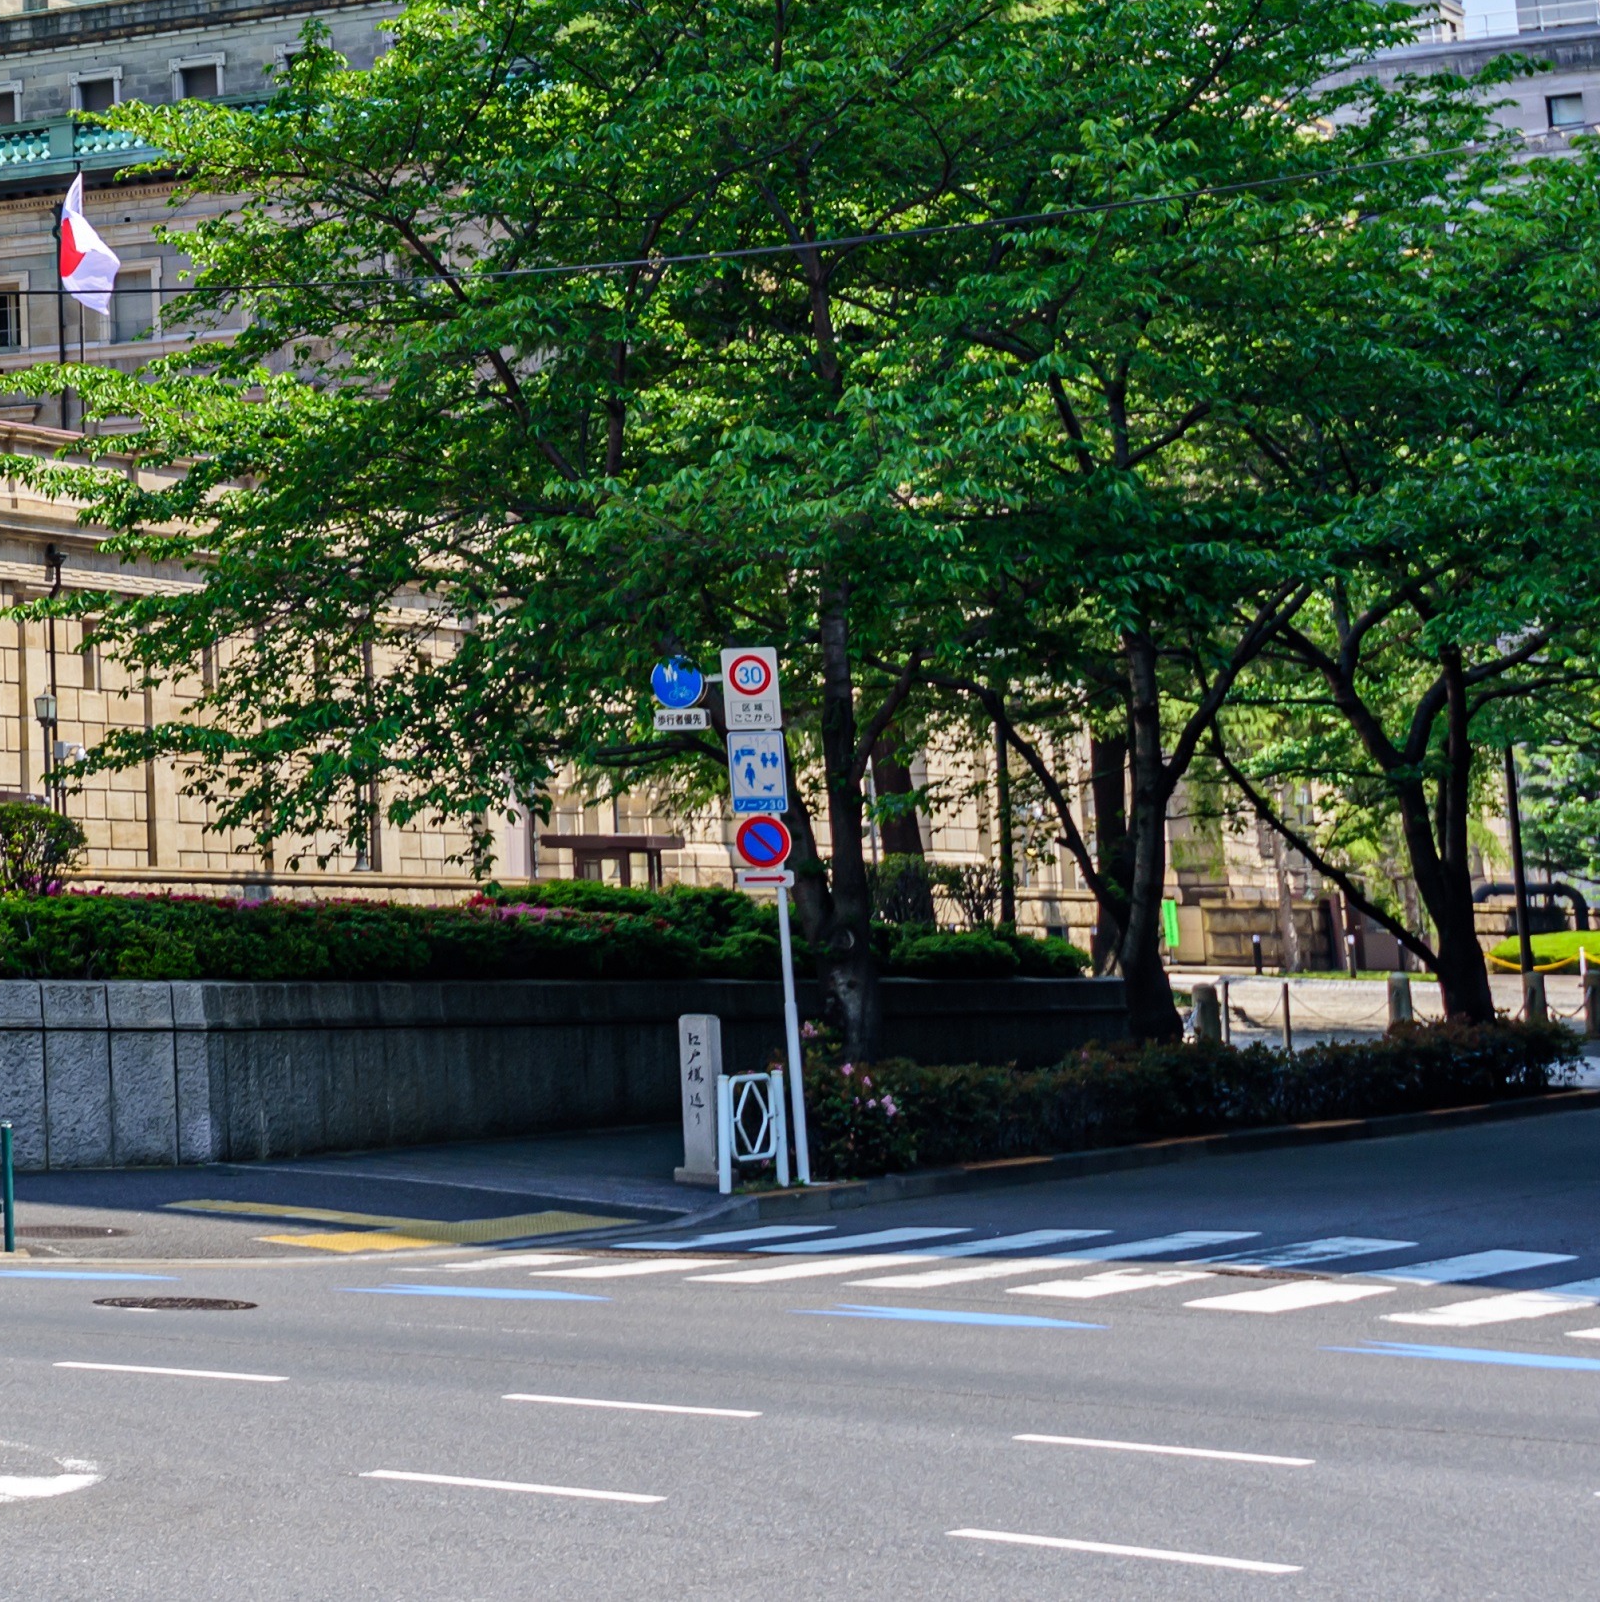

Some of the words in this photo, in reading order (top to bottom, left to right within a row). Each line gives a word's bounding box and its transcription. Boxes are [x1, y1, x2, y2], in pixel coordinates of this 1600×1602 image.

[738, 666, 763, 685] 30
[742, 703, 764, 712] 区域
[657, 714, 702, 725] 歩行者優先
[734, 713, 773, 723] ここから
